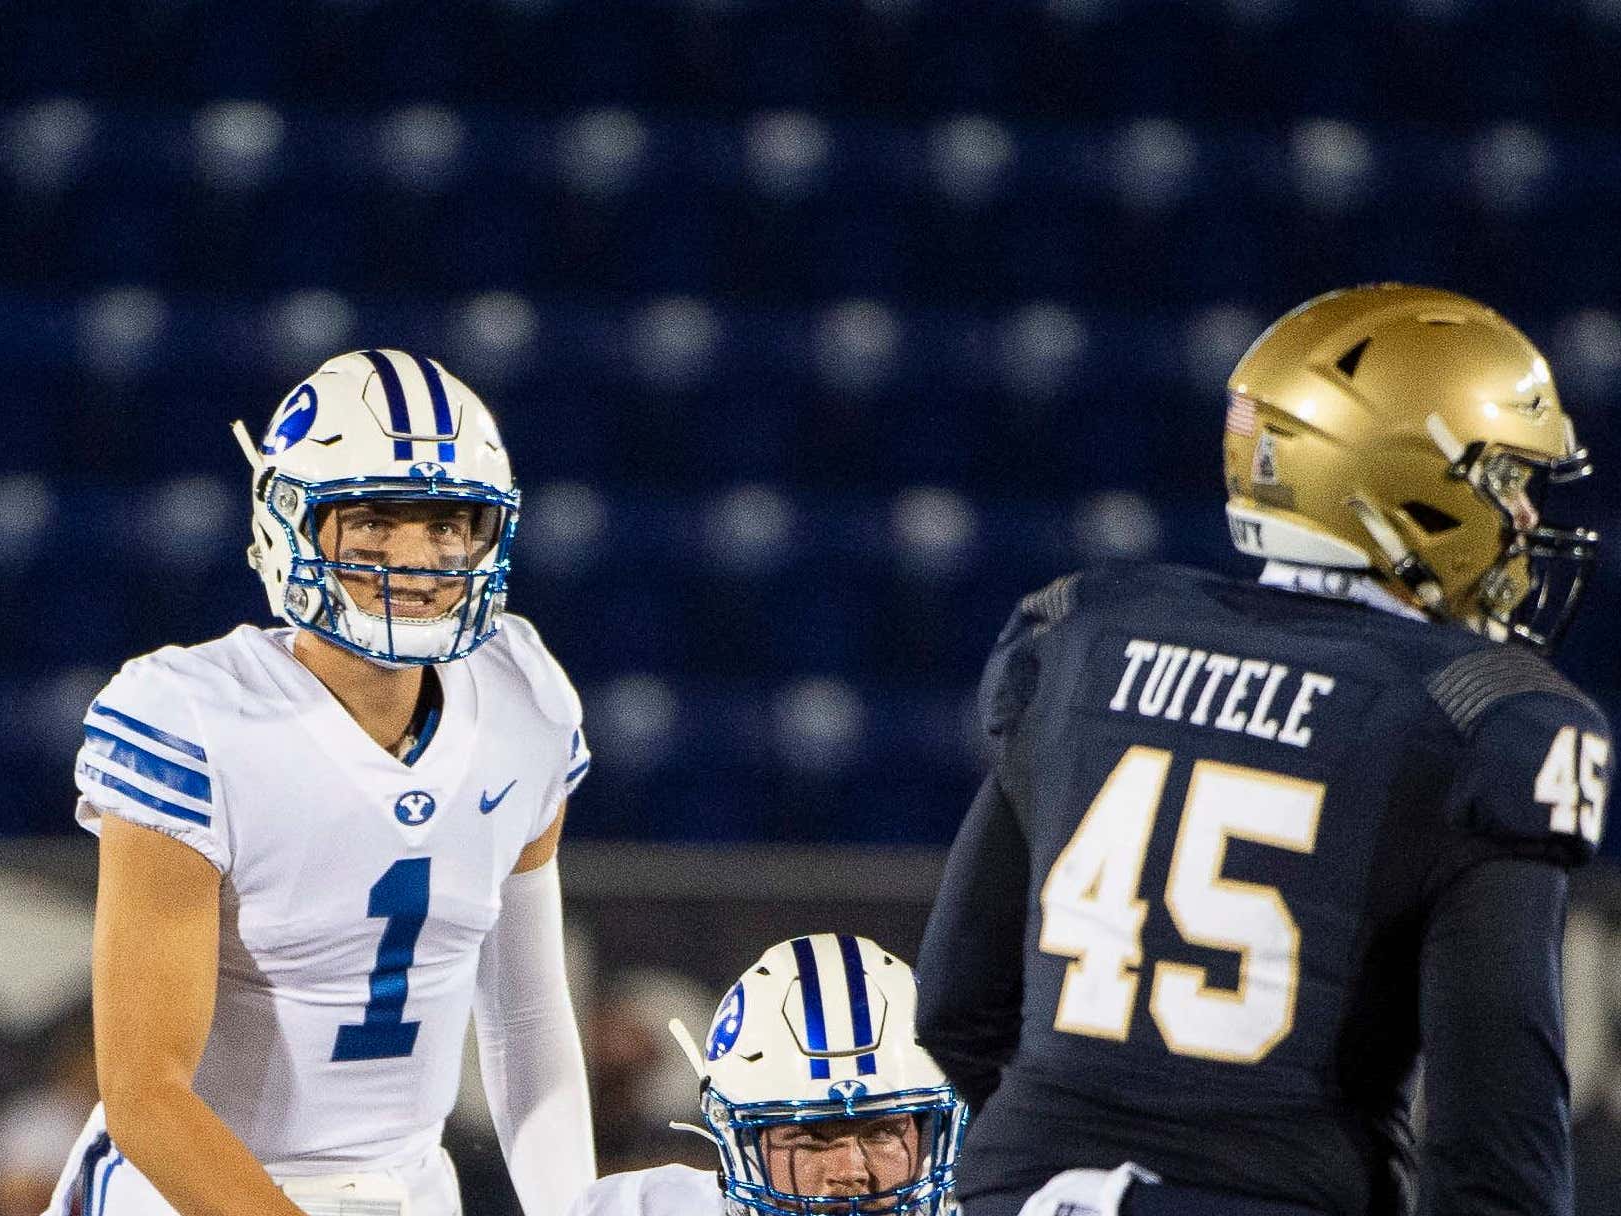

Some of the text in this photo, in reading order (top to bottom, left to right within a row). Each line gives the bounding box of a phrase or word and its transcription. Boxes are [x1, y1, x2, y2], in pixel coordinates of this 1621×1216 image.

[1109, 639, 1335, 748] TUITELE
[1532, 725, 1609, 845] 45
[331, 857, 432, 1063] 1
[1039, 744, 1327, 1066] 45
